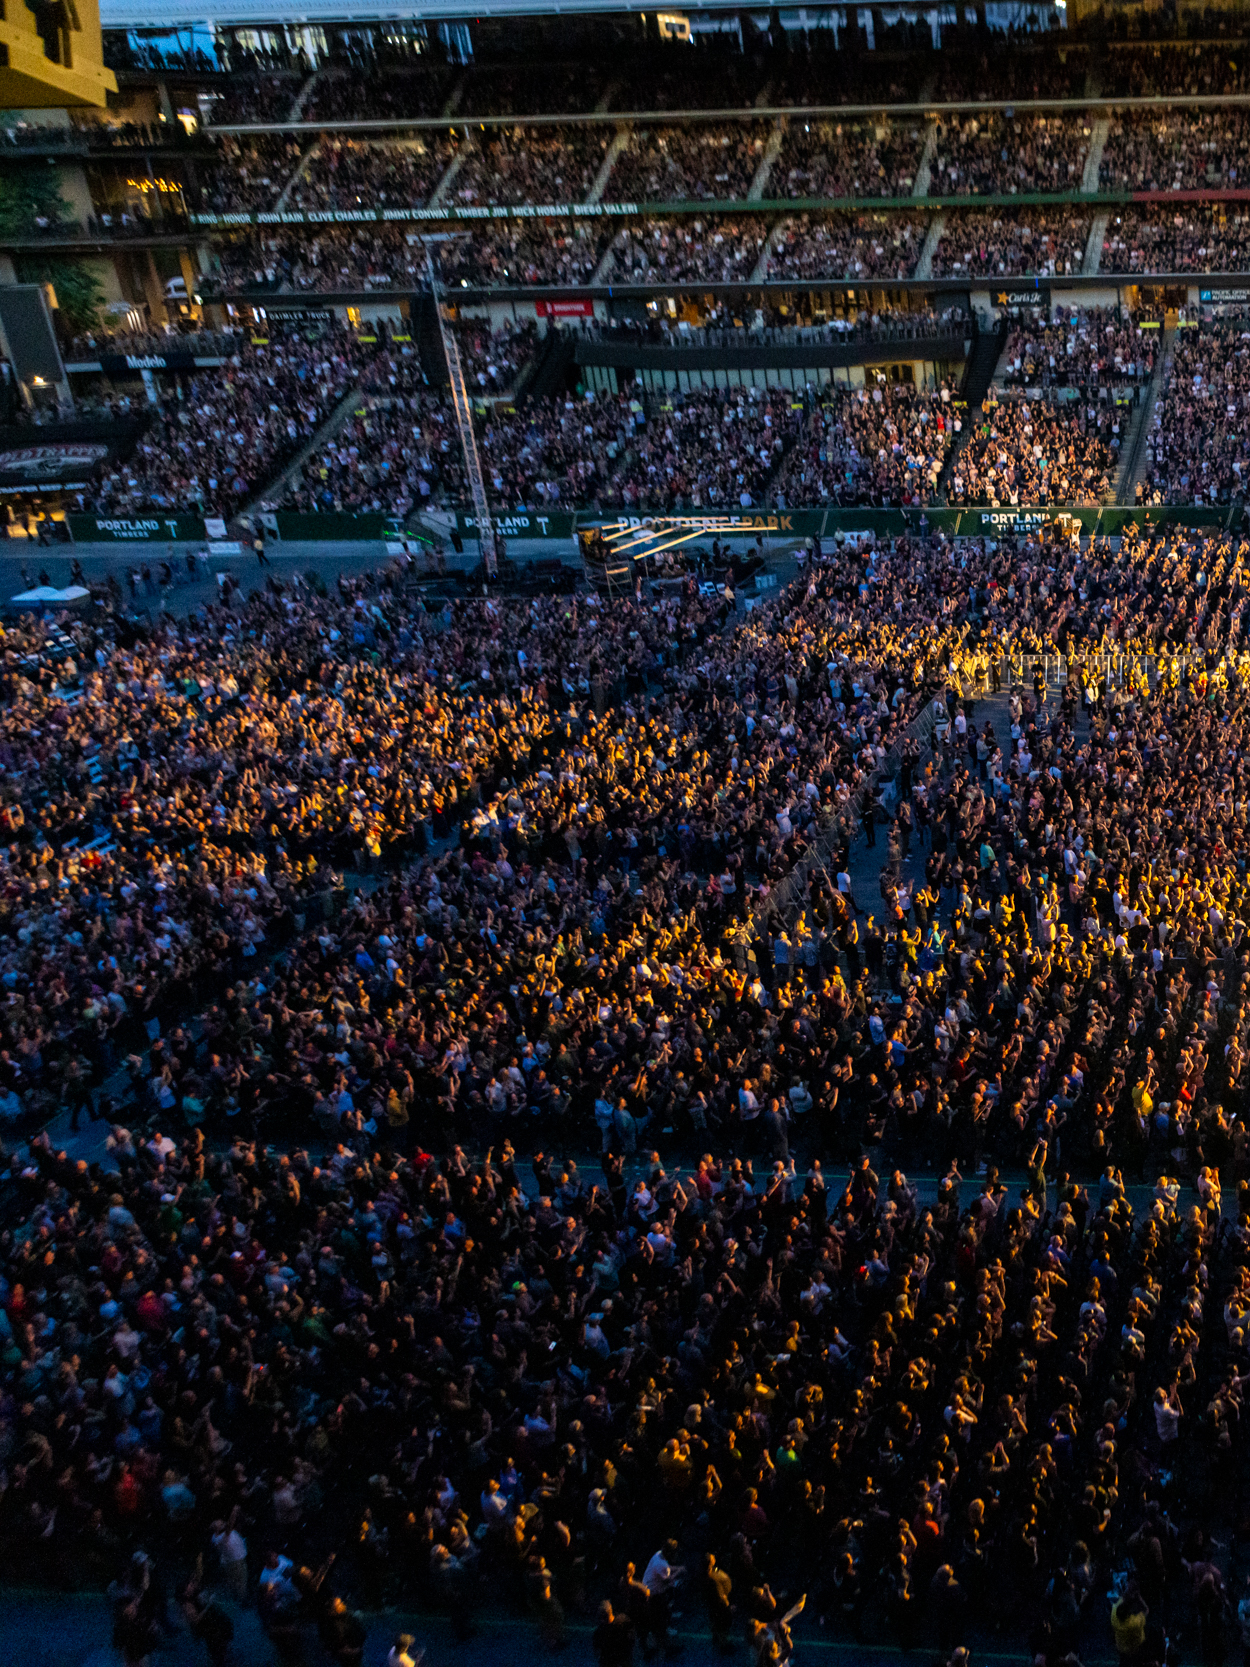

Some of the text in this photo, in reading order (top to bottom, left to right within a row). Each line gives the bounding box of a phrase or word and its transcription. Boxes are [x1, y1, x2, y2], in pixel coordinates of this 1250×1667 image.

[335, 209, 377, 222] CHARLES
[383, 208, 410, 220] JIMMY
[411, 208, 449, 220] CONWAY
[126, 354, 166, 369] Modelo
[96, 520, 159, 530] PORTLAND
[742, 516, 794, 530] PARK
[112, 530, 150, 538] TIMBERS
